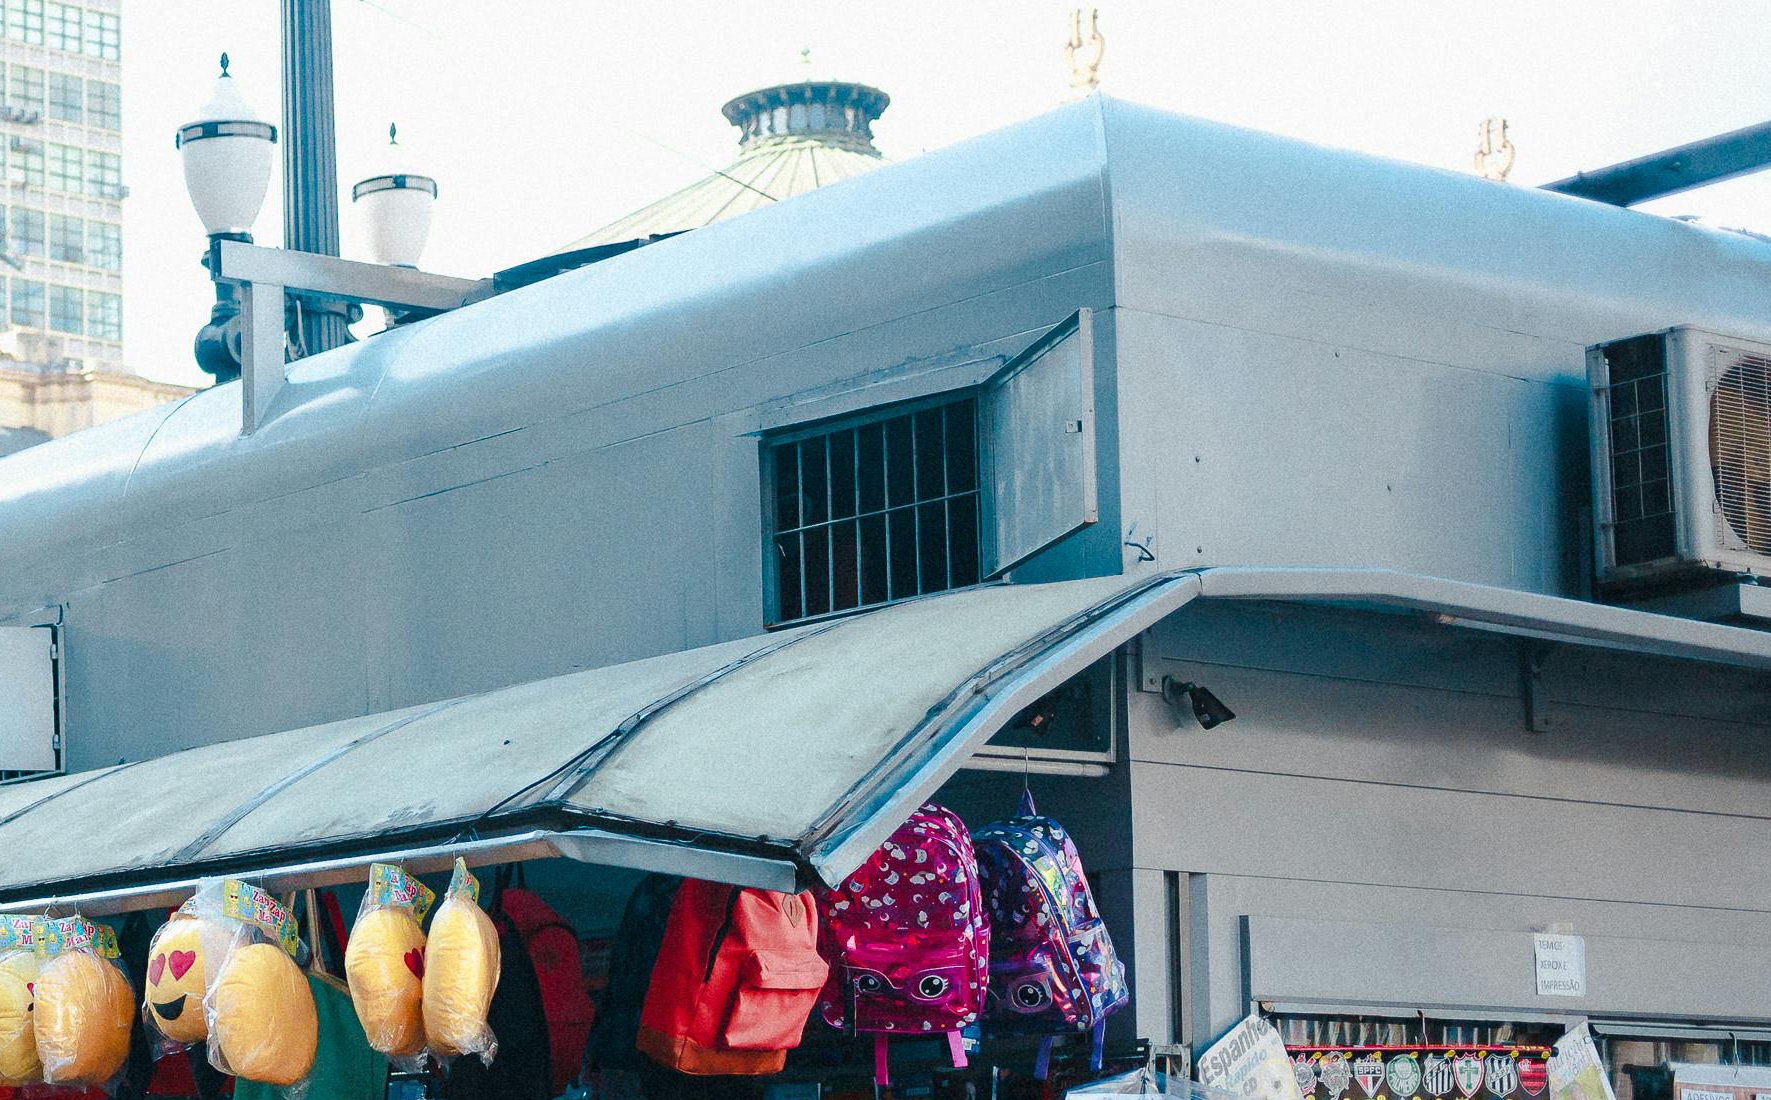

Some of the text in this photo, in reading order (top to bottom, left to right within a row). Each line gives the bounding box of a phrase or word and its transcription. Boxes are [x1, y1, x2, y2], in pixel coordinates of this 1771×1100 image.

[1539, 940, 1563, 950] TEMOS
[1540, 960, 1563, 970] XEROX
[1541, 979, 1580, 991] IMPRESSÃO
[1358, 1066, 1381, 1074] SPFC
